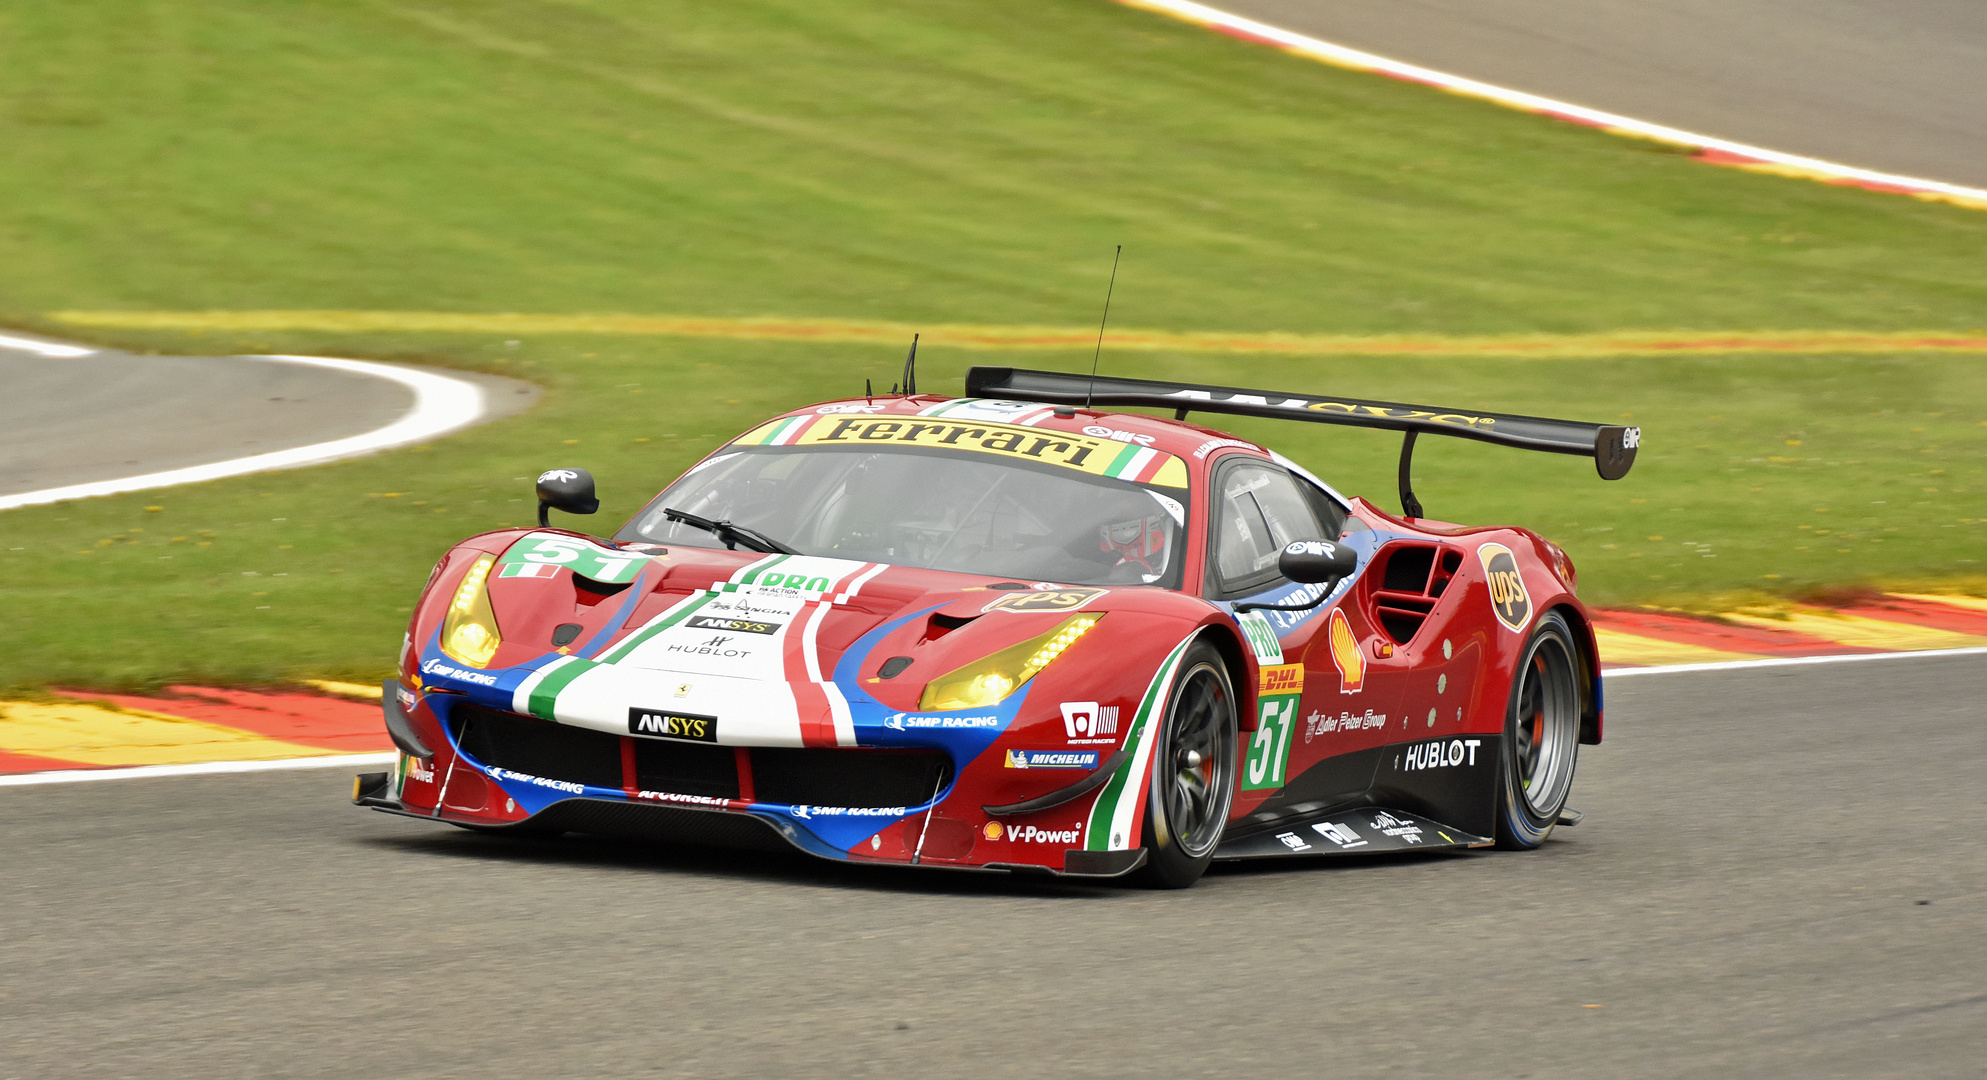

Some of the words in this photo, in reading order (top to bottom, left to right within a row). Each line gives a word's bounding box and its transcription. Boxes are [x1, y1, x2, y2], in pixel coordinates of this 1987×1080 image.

[816, 418, 1100, 467] Ferrari
[523, 540, 633, 581] 51
[1489, 571, 1525, 617] ups
[696, 618, 769, 632] ANSYS
[1242, 618, 1280, 658] PRO
[667, 644, 752, 659] HUBLOT
[433, 665, 452, 677] SMP
[451, 669, 497, 685] RACING
[1264, 668, 1298, 690] DHL
[637, 713, 705, 738] ANSYS
[906, 716, 941, 727] SMP
[942, 716, 998, 727] RACING
[1315, 714, 1338, 735] Adler
[1337, 711, 1363, 733] Pelzer
[1362, 709, 1387, 730] Group
[1249, 698, 1295, 785] 51
[1030, 753, 1096, 765] MICHELIN
[1404, 739, 1482, 772] HUBLOT
[533, 777, 585, 795] RACING
[811, 805, 847, 816] SMP
[847, 806, 906, 817] RACING
[1006, 825, 1082, 844] V-Power
